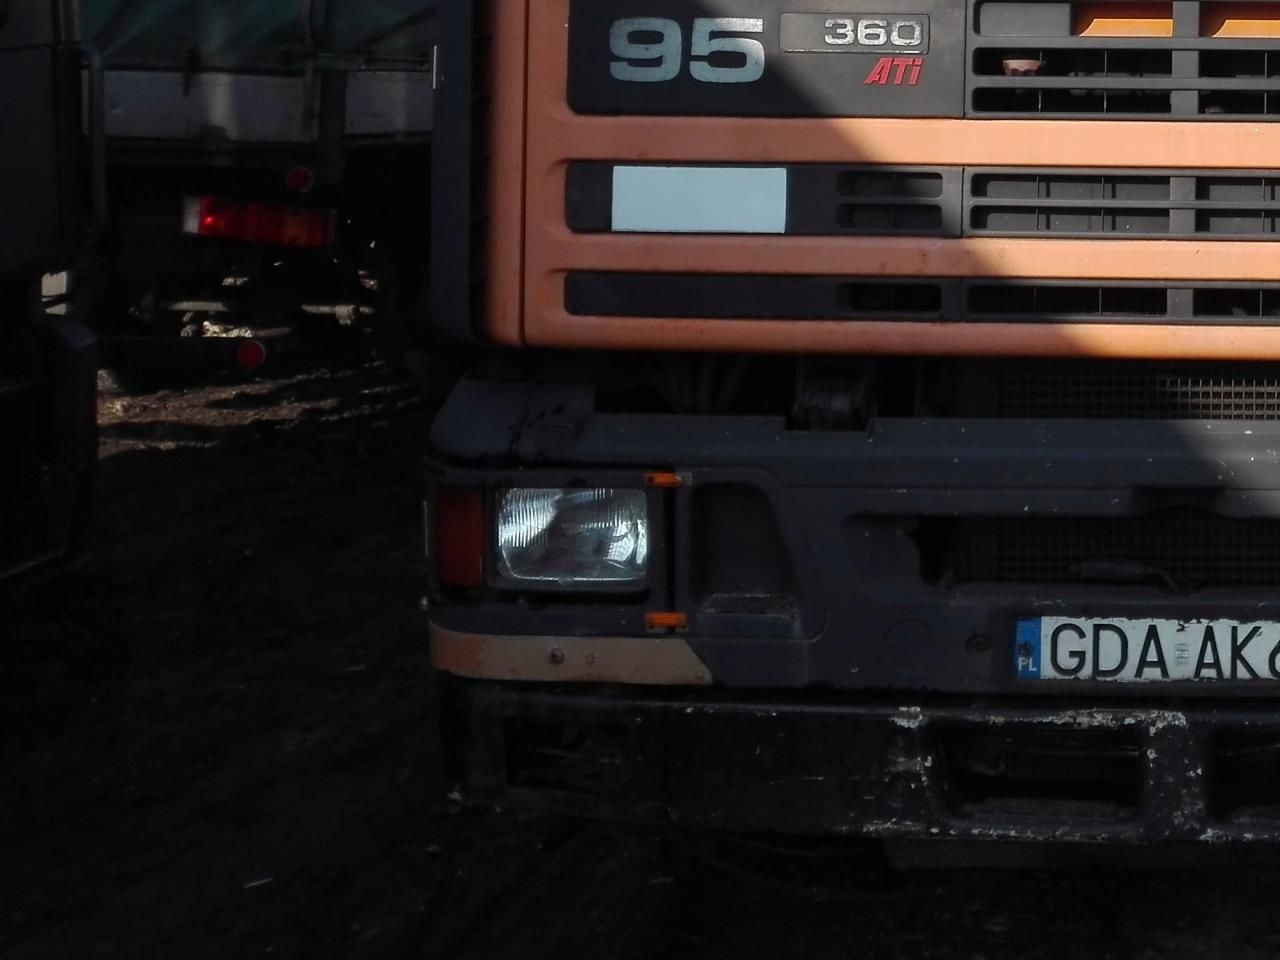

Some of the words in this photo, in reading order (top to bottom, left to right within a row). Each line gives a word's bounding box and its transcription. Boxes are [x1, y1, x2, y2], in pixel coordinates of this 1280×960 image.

[823, 18, 922, 47] 360
[609, 16, 766, 84] 95
[864, 56, 923, 86] ATi
[1017, 656, 1038, 672] PL
[1049, 622, 1170, 680] GDA
